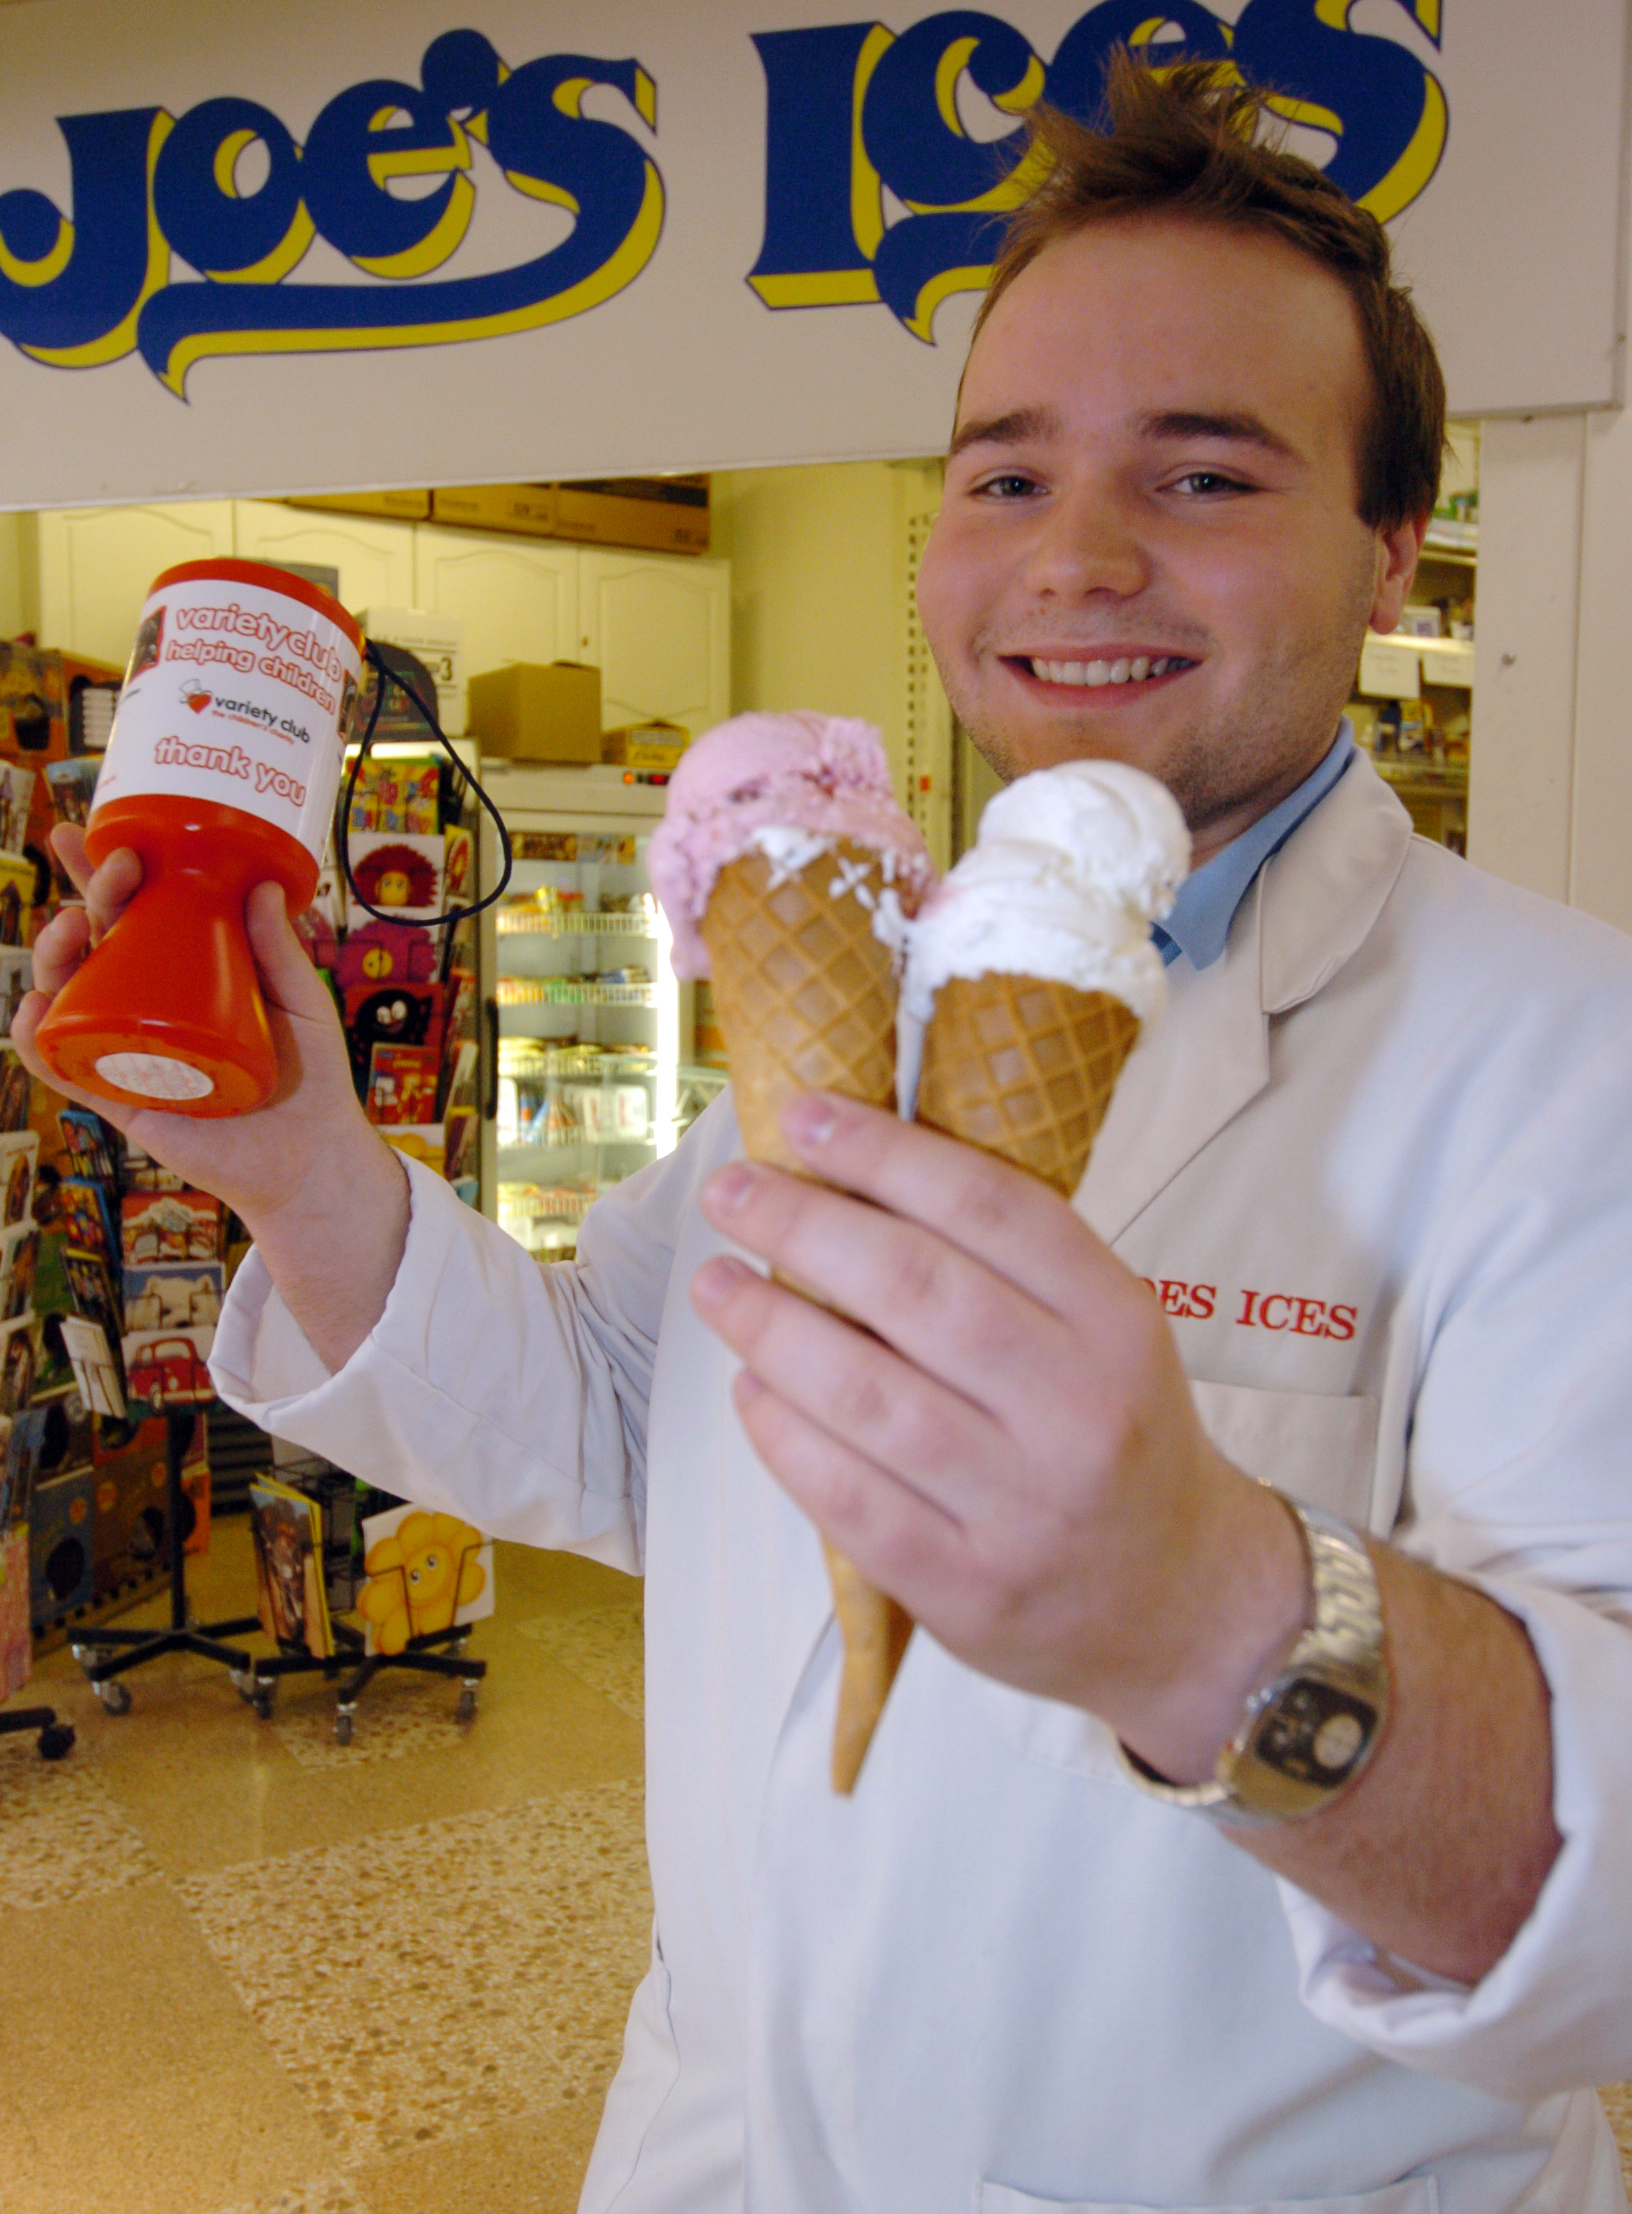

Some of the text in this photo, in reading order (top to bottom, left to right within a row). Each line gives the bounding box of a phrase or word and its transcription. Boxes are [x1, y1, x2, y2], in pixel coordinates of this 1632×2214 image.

[165, 638, 336, 716] helping children
[215, 697, 310, 744] variety club
[154, 735, 250, 780] thank
[254, 762, 307, 808] you
[1138, 1276, 1359, 1341] ES ICES
